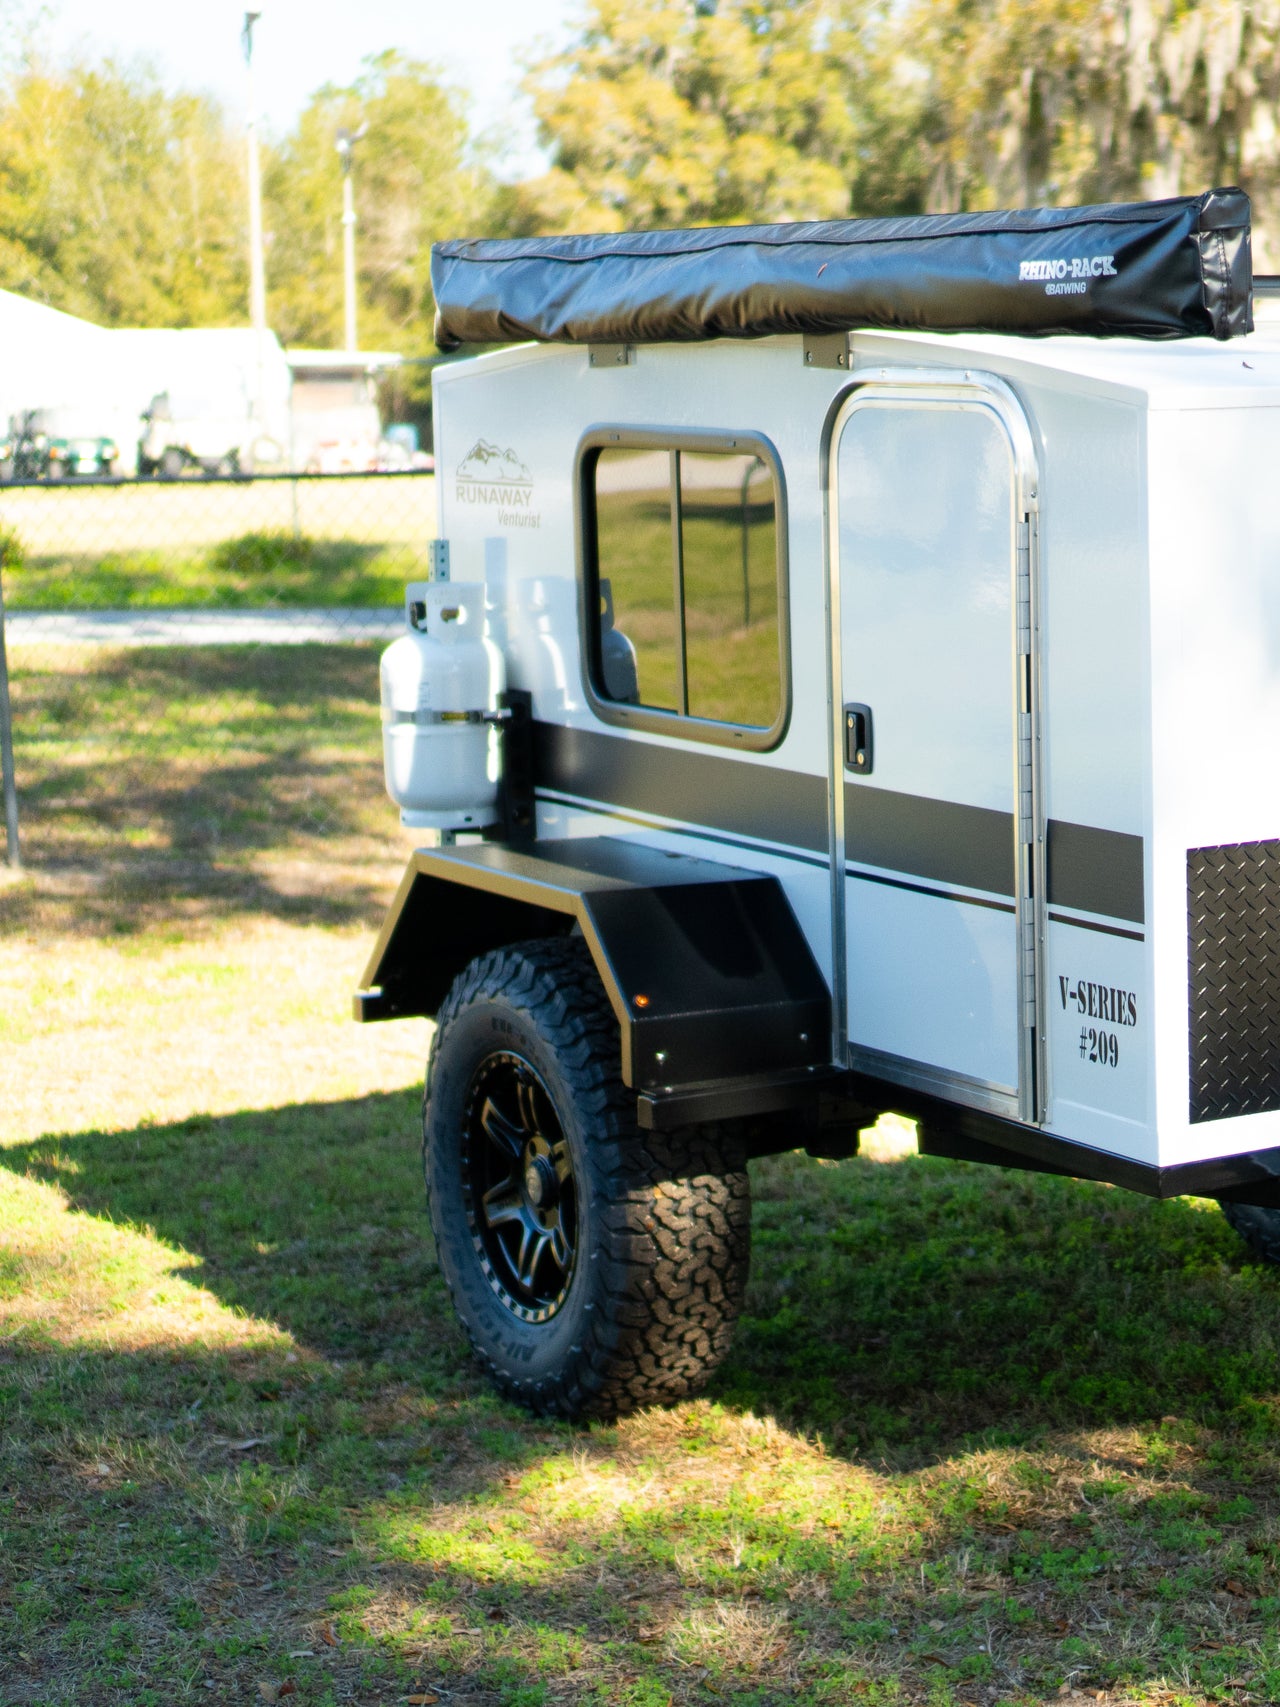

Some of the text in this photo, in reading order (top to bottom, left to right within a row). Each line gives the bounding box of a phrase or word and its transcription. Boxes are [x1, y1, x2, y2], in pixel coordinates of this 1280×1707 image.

[1019, 256, 1117, 280] RHINO-RACK
[1049, 282, 1086, 295] BATWING
[456, 486, 532, 507] RUNAWAY
[498, 509, 541, 528] Venturist
[1059, 975, 1137, 1027] V-SERIES
[1079, 1026, 1119, 1068] #209
